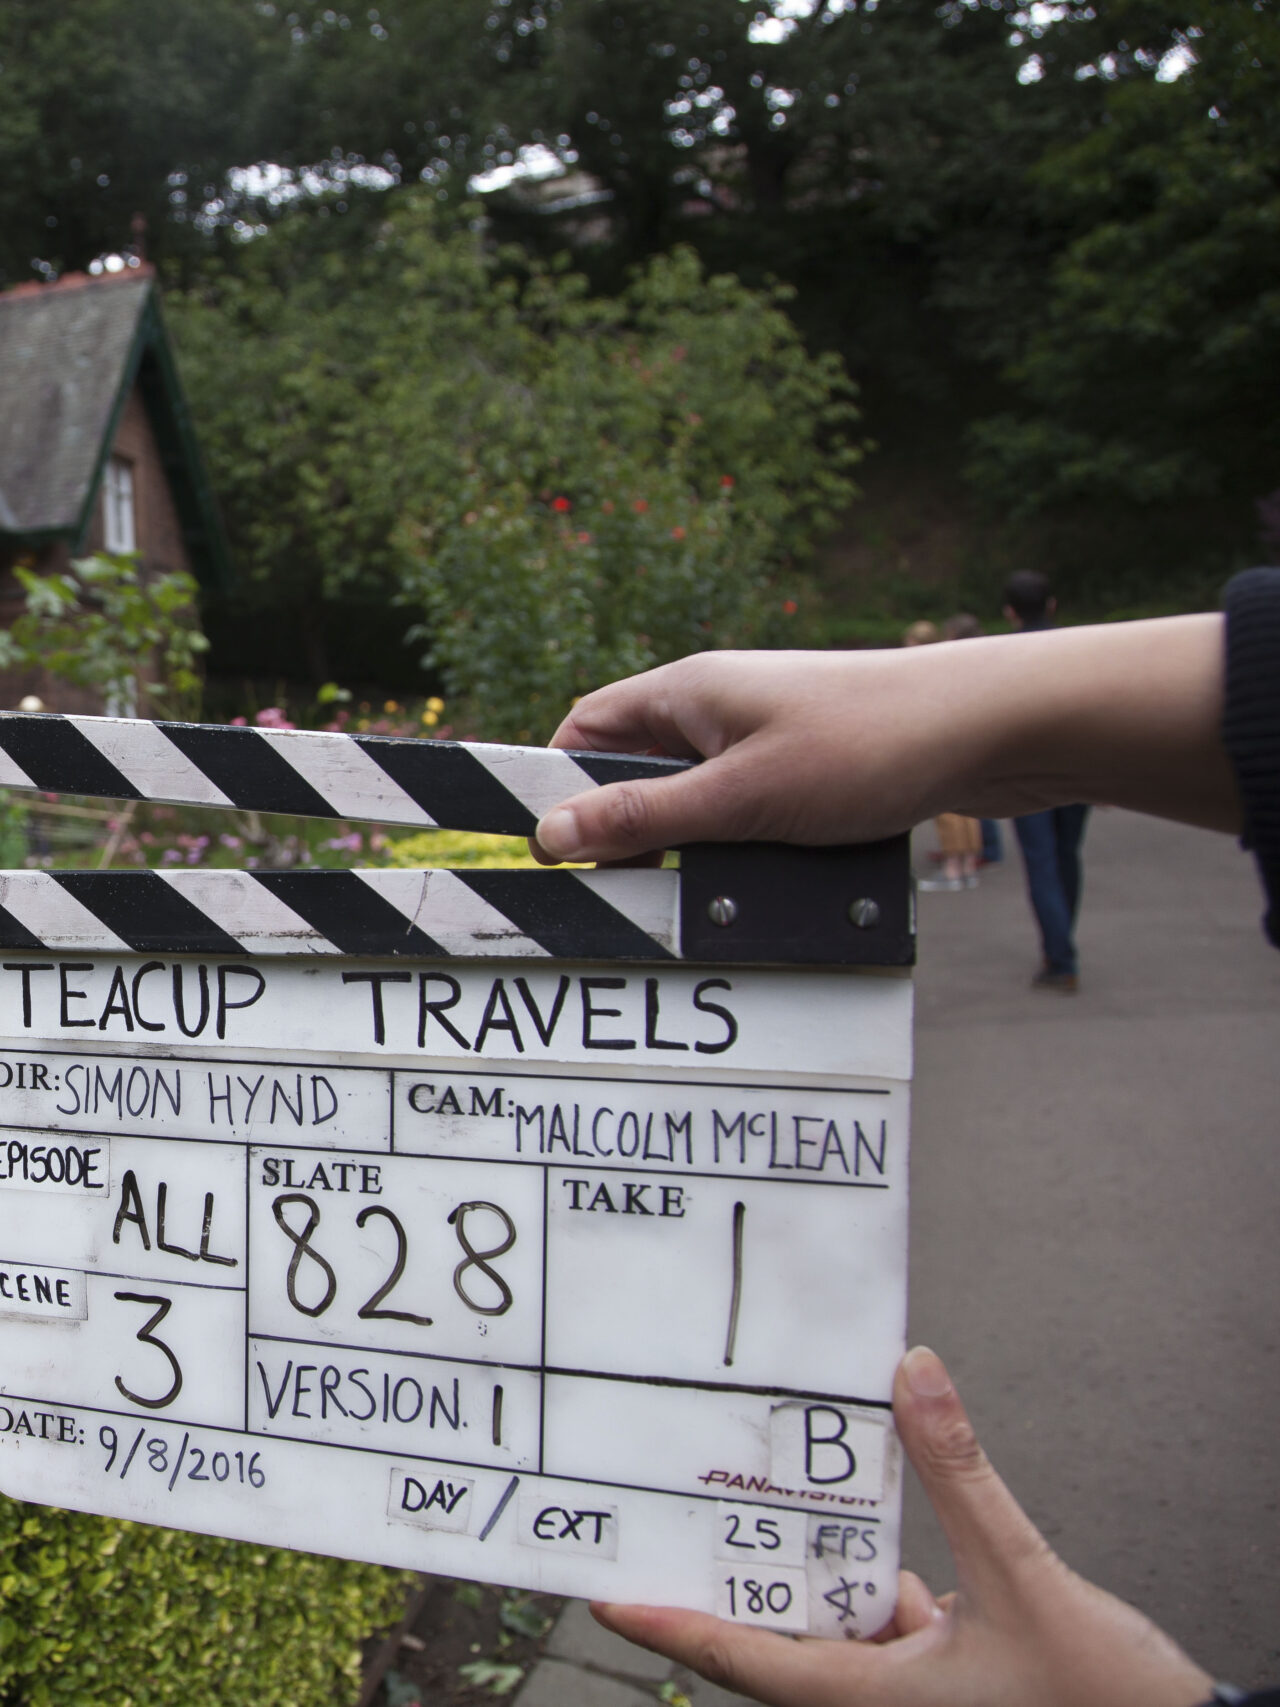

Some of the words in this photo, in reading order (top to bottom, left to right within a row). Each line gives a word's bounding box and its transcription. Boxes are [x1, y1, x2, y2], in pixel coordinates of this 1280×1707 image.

[3, 961, 266, 1040] TEACUP
[342, 971, 738, 1054] TRAVELS
[56, 1064, 181, 1120] SIMON
[208, 1072, 339, 1126] HYND
[515, 1103, 693, 1164] MALCOLM
[261, 1157, 384, 1195] SLATE
[562, 1179, 686, 1218] TAKE
[112, 1169, 238, 1268] ALL
[271, 1193, 517, 1326] 828
[114, 1291, 183, 1409] 3
[99, 1425, 266, 1491] 9/8/2016
[804, 1405, 856, 1485] B
[401, 1477, 468, 1513] DAY
[533, 1507, 613, 1545] EXT
[724, 1514, 782, 1550] 25
[814, 1524, 878, 1561] FPS
[724, 1576, 793, 1617] 180
